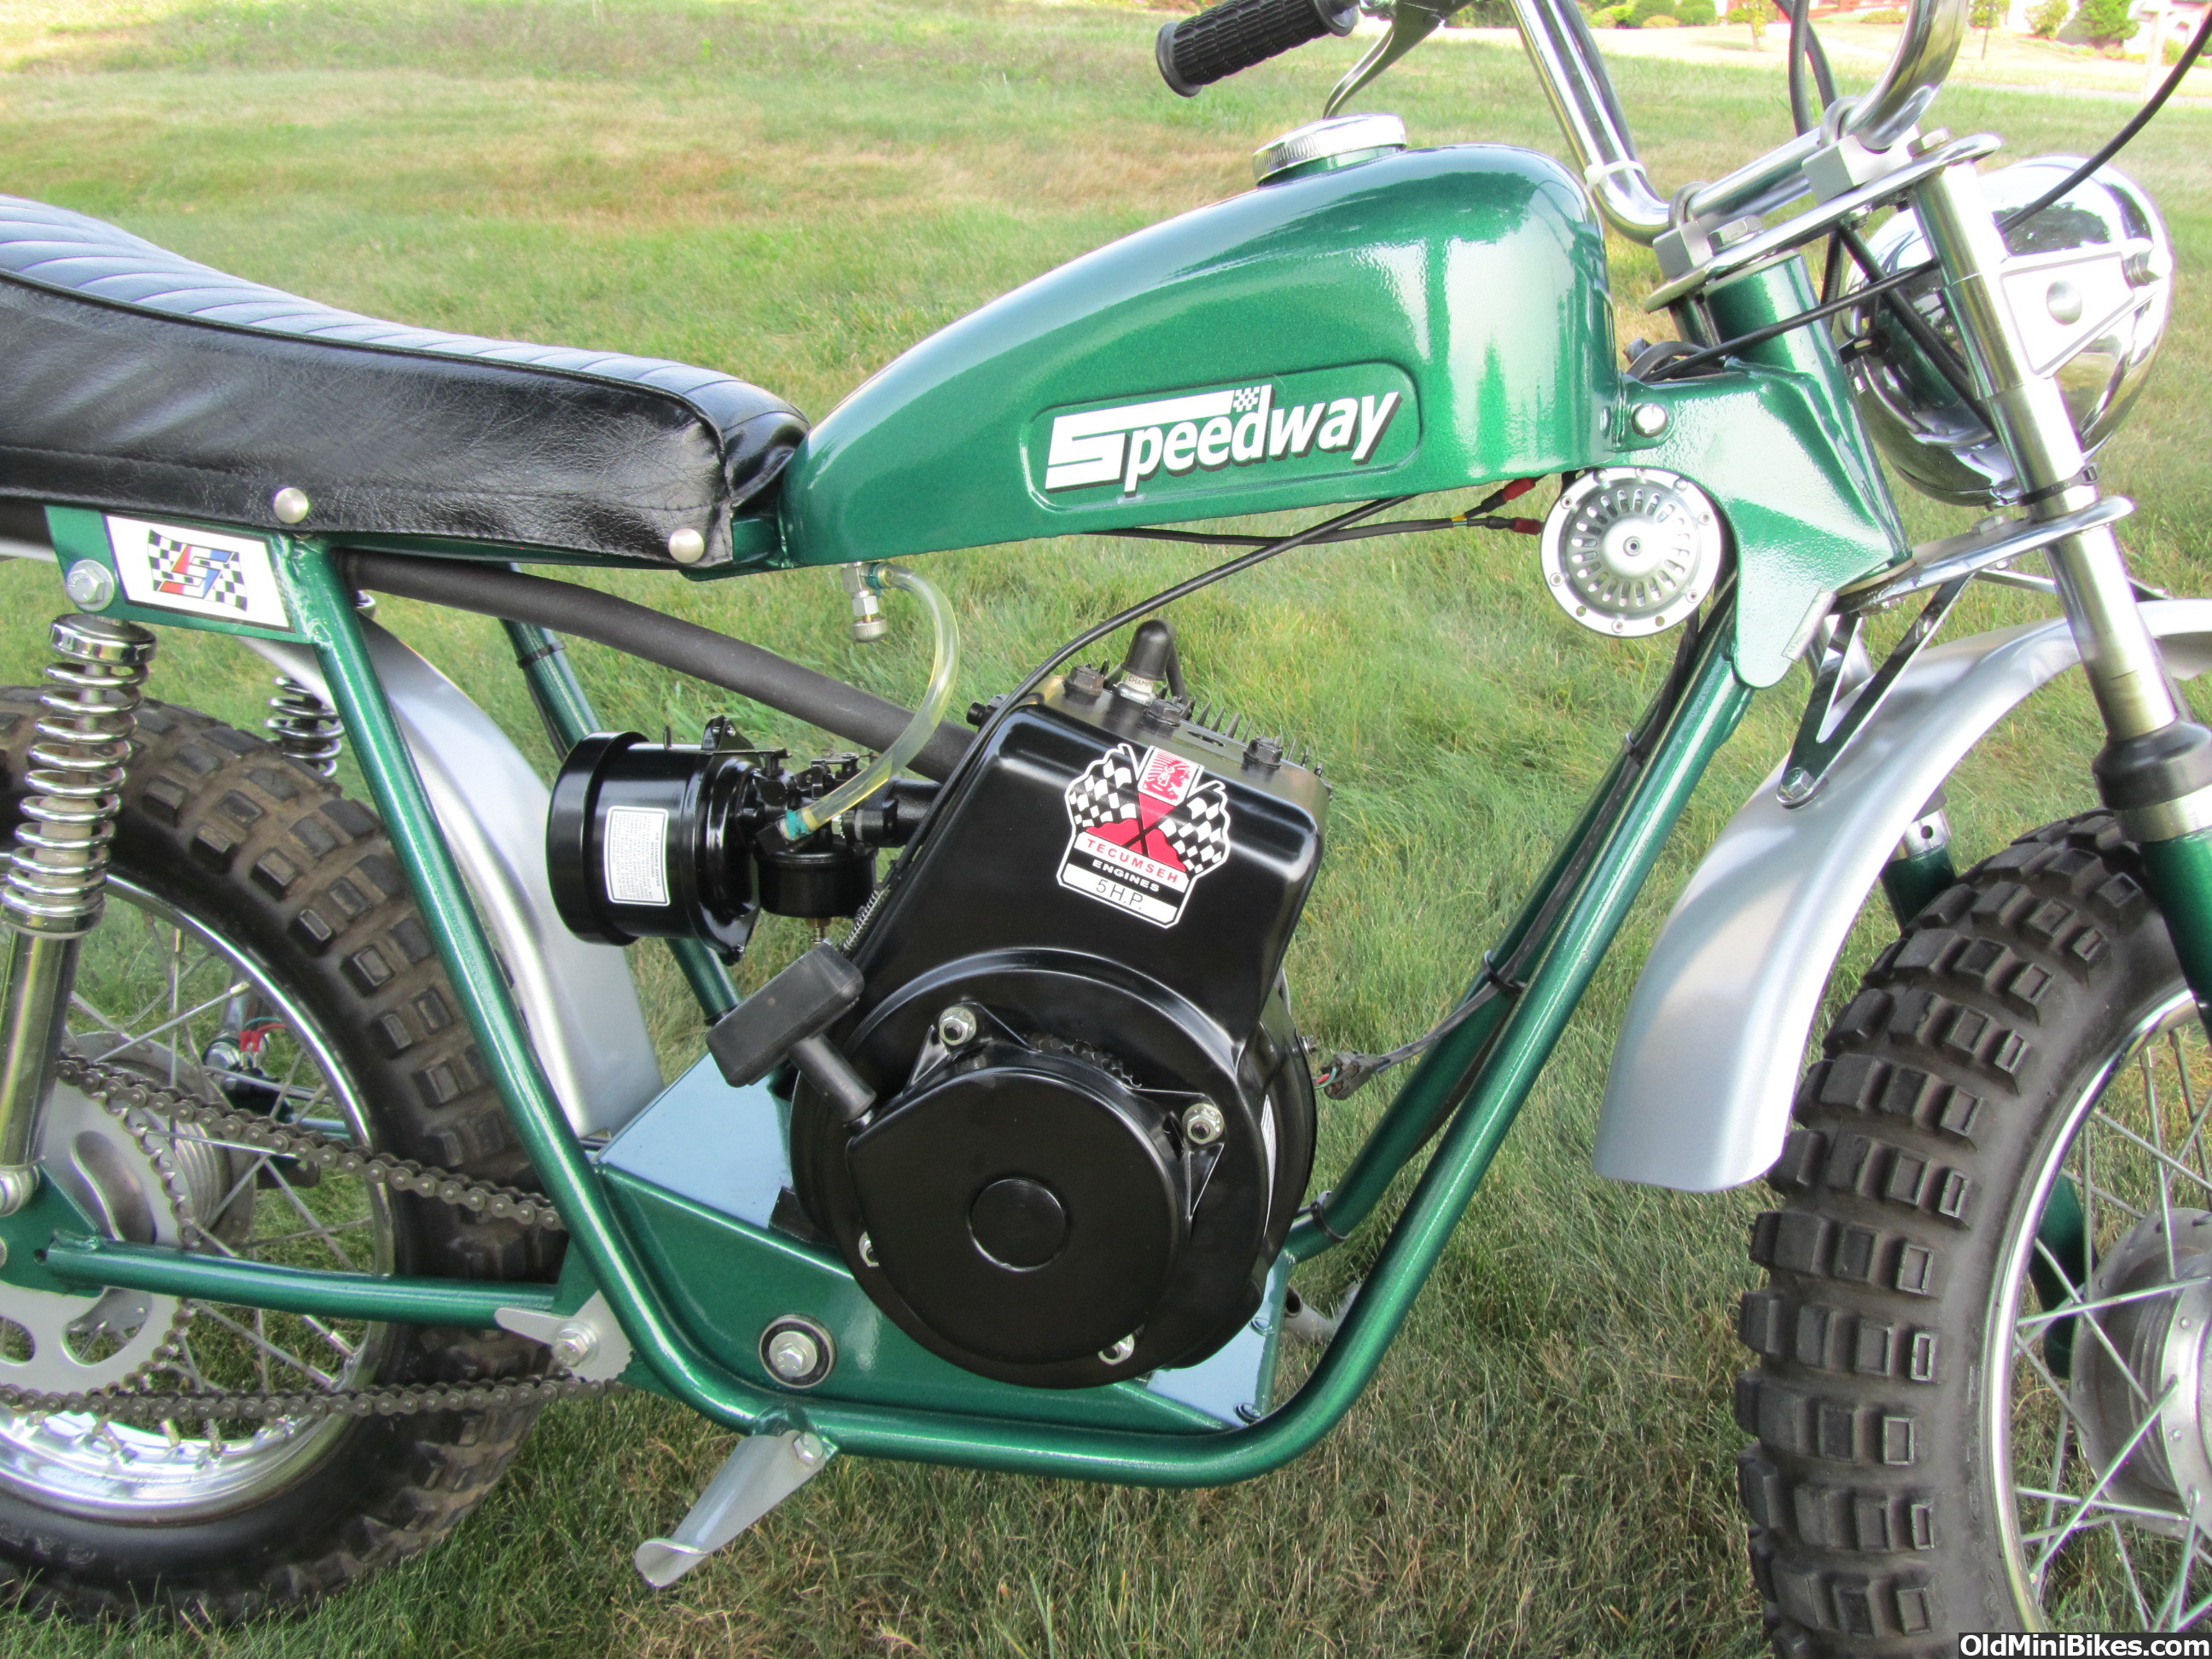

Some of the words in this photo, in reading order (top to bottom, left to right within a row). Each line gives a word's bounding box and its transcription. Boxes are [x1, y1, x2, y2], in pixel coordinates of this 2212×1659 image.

[1045, 384, 1401, 497] Speedway
[1087, 838, 1179, 883] TECUMSEH
[1091, 859, 1160, 892] ENGINES
